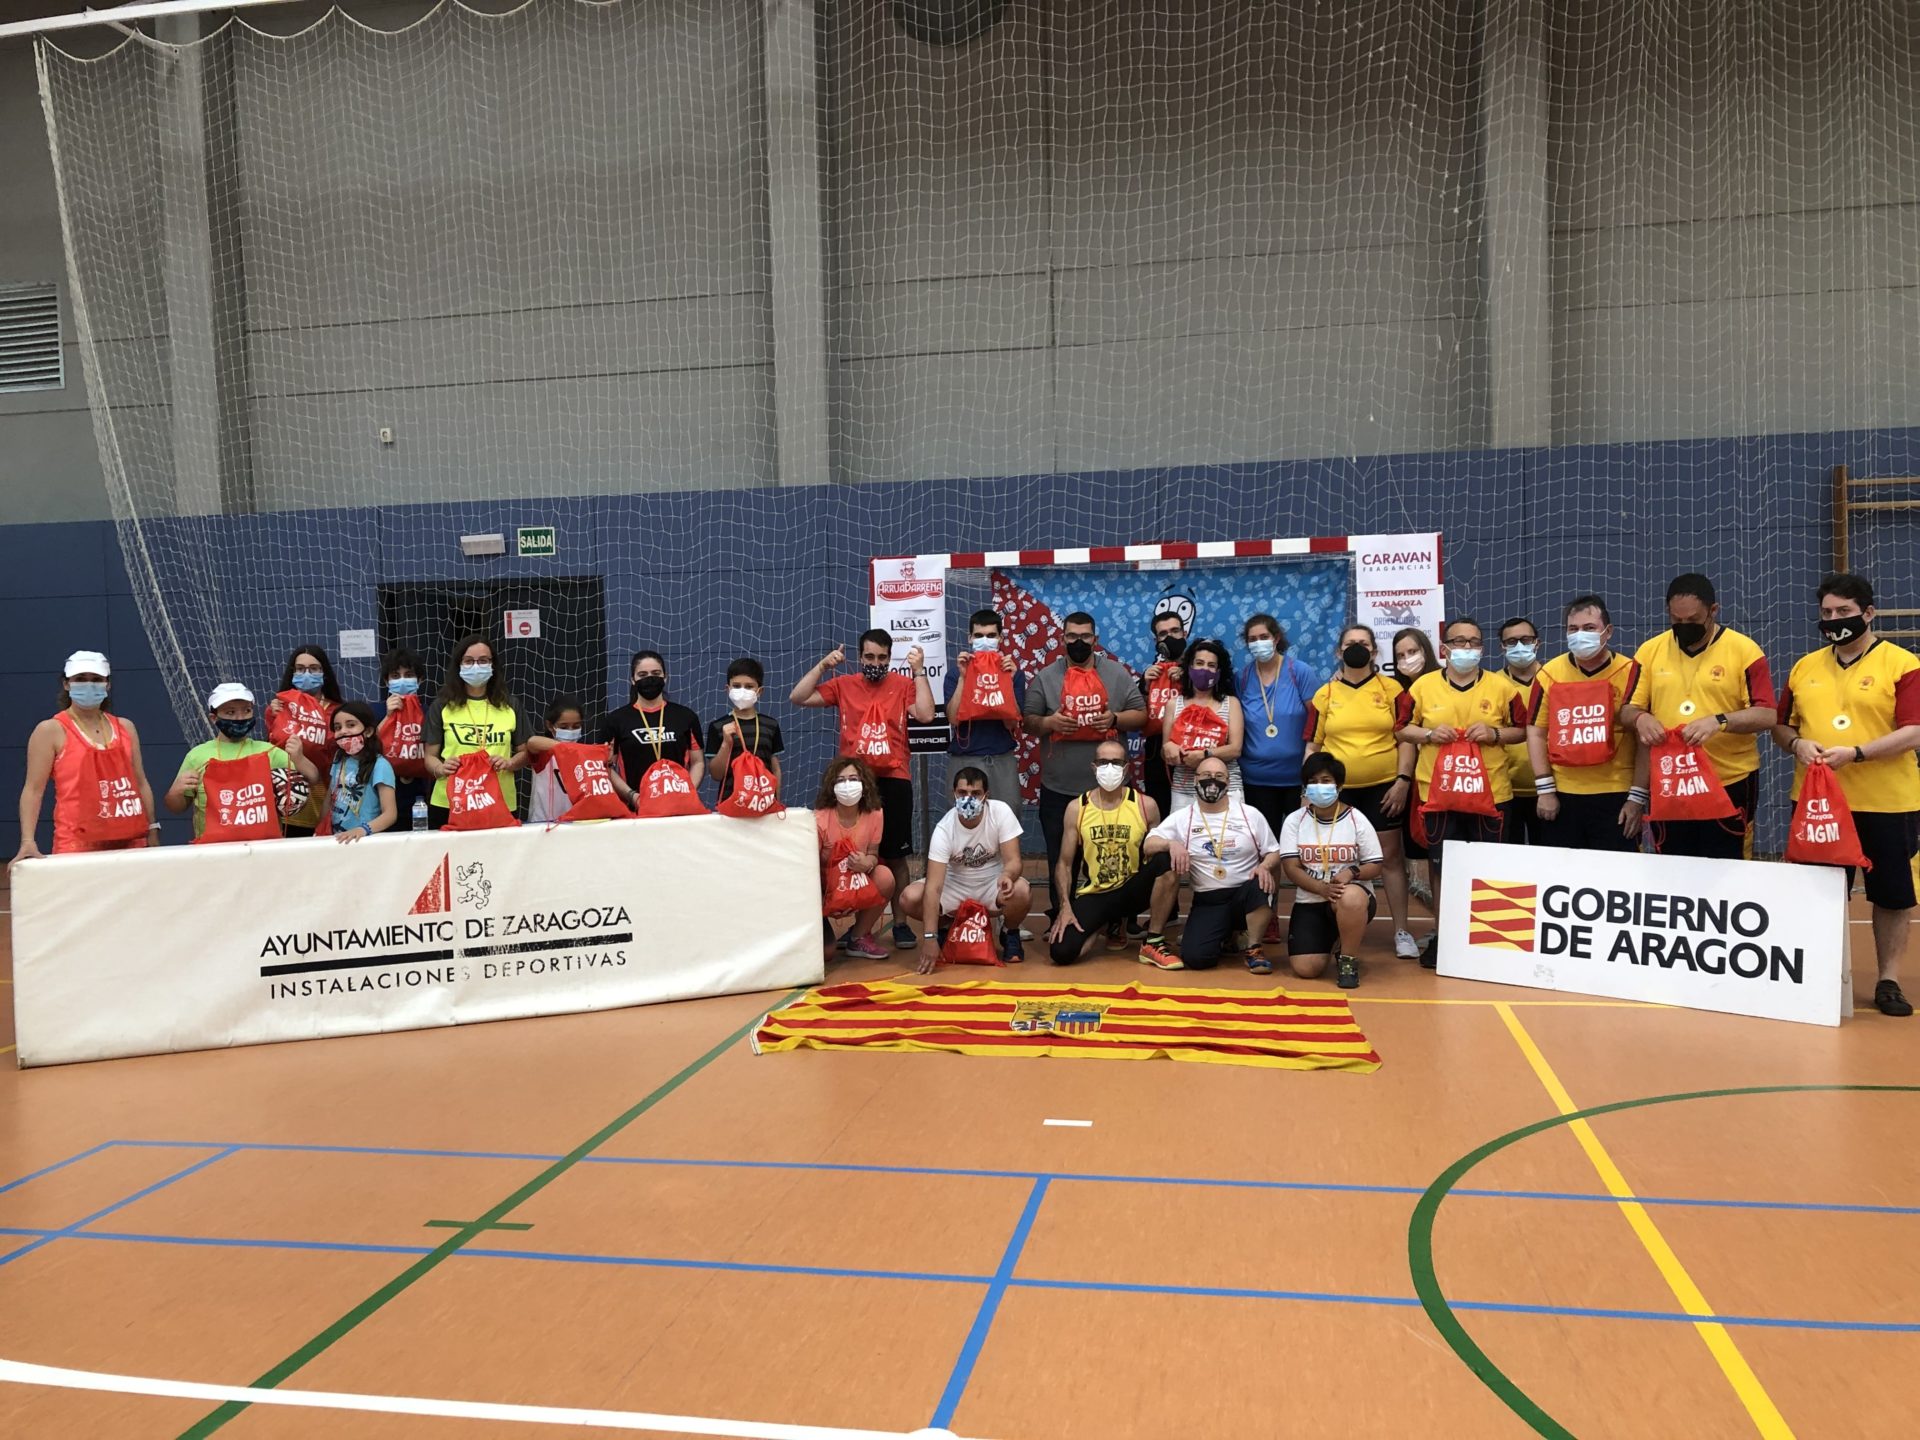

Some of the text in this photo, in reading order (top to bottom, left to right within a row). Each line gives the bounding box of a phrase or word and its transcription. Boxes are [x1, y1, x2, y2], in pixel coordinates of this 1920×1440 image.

[520, 535, 552, 548] SALIDA
[1362, 552, 1431, 565] CARAVAN
[1363, 564, 1431, 572] FRAGANCIAS
[1372, 600, 1422, 608] ZARAGOZA
[891, 619, 930, 630] LACASA
[981, 690, 1005, 707] AGM
[1075, 694, 1101, 706] CUD
[1572, 704, 1605, 718] CUD
[297, 724, 326, 745] AGM
[1572, 725, 1606, 744] AGM
[867, 740, 891, 755] AGM
[236, 783, 265, 801] CUD
[663, 779, 690, 794] AGM
[1452, 776, 1484, 793] AGM
[1676, 776, 1710, 796] AGM
[114, 797, 143, 818] AGM
[467, 792, 496, 811] AGM
[747, 794, 775, 812] AGM
[234, 805, 268, 825] AGM
[1807, 822, 1840, 843] AGM
[1542, 884, 1769, 938] GOBIERNO
[465, 917, 495, 939] DE
[502, 906, 632, 936] ZARAGOZA
[1540, 922, 1804, 984] DE ARAGON
[271, 951, 627, 999] INSTALACIONES DEPORTIVAS
